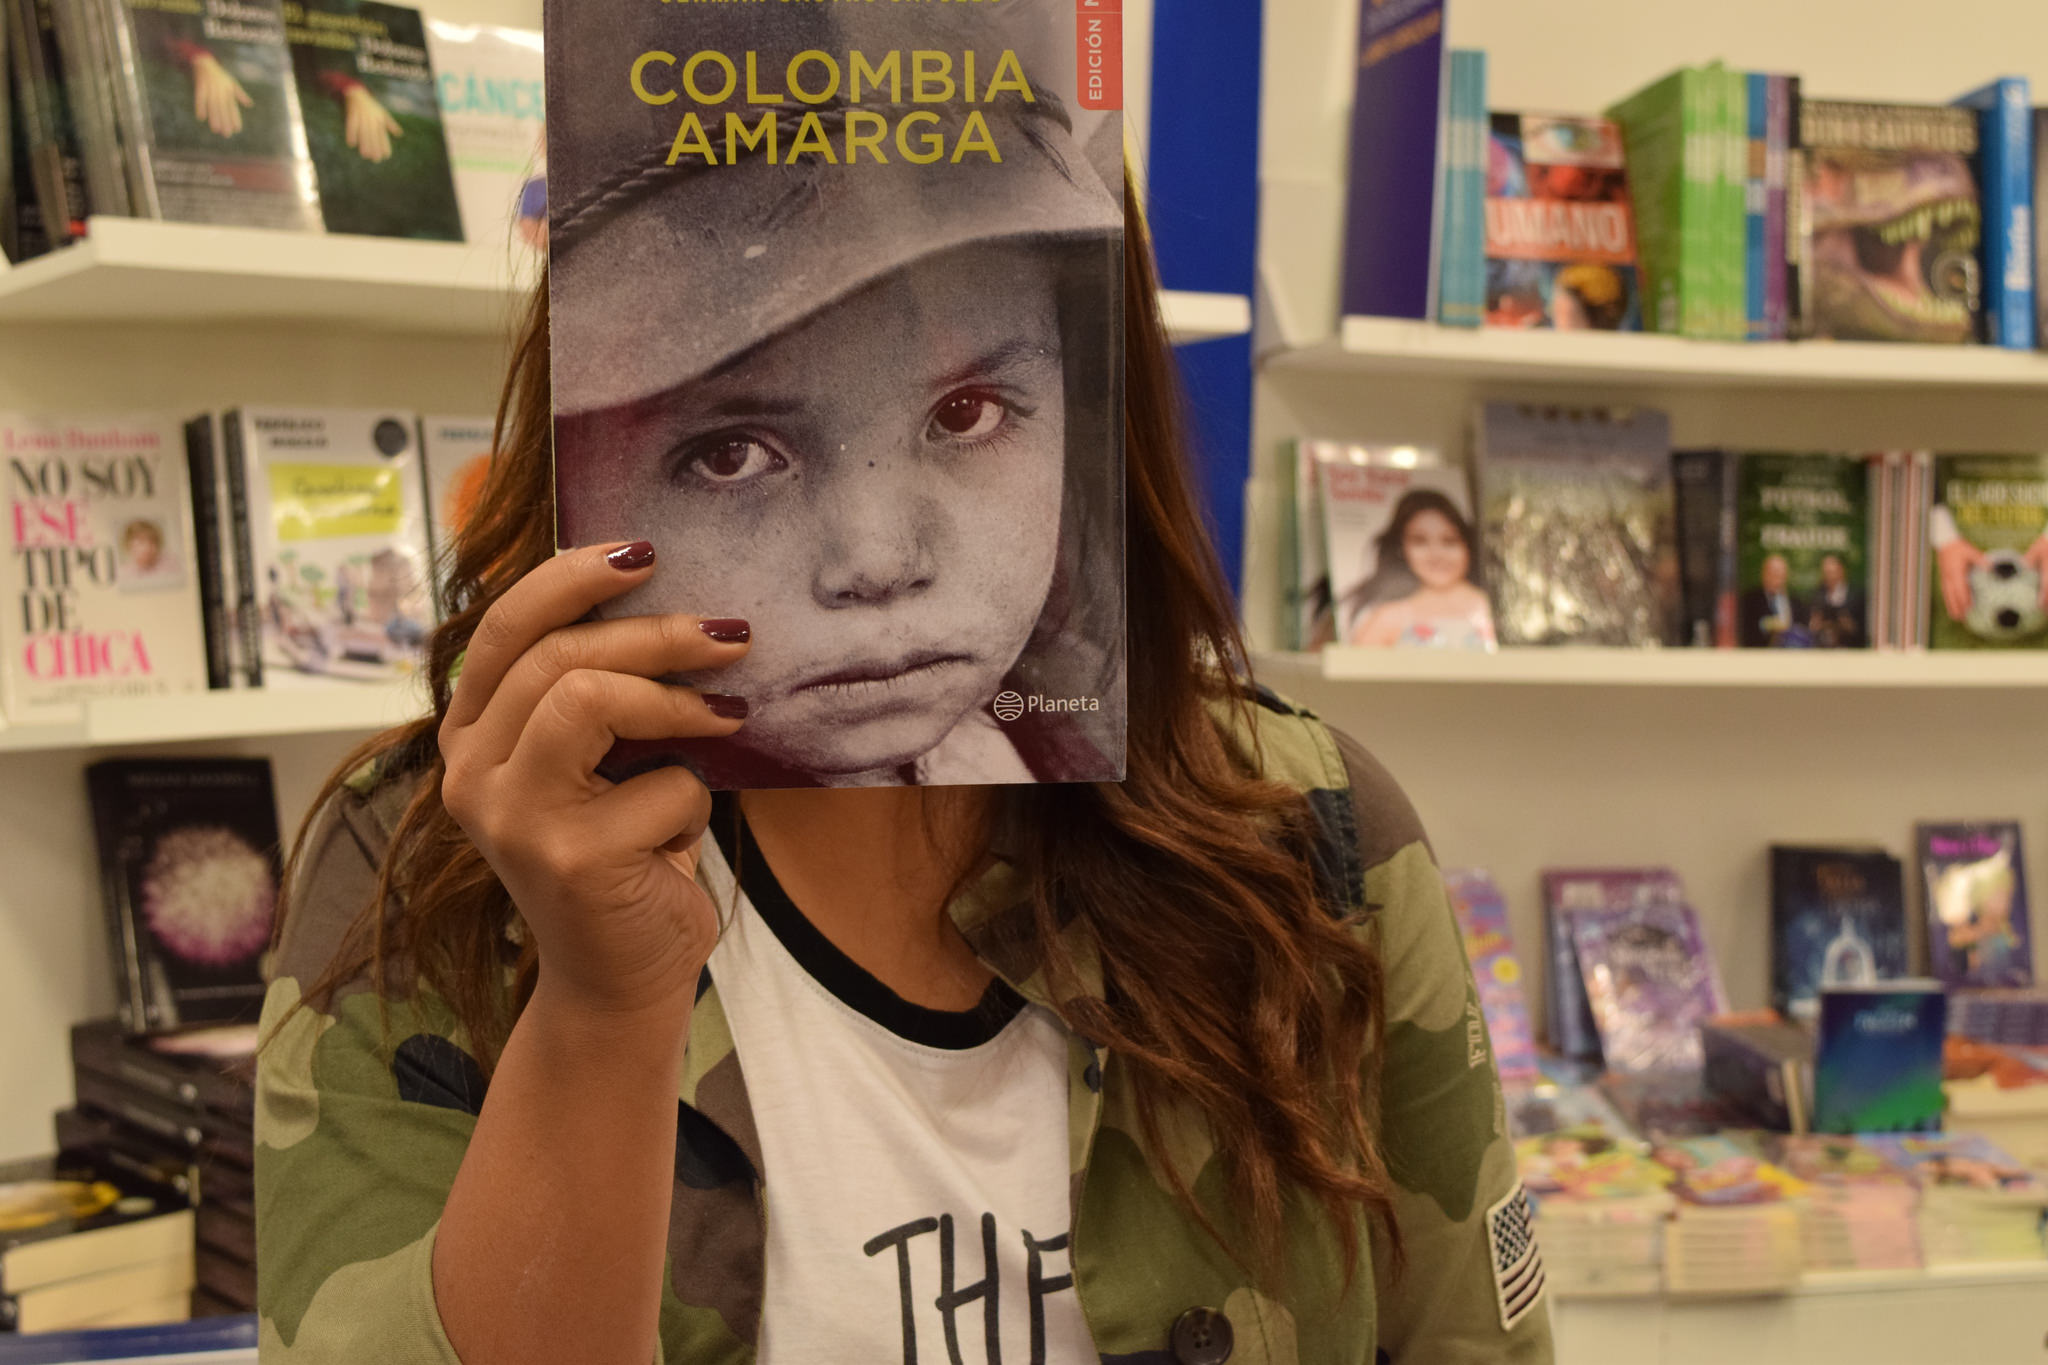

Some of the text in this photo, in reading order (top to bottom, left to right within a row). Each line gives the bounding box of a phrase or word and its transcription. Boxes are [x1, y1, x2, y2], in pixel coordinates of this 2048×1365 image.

[630, 49, 1036, 104] COLOMBIA
[1085, 19, 1102, 100] EDICIÓN
[665, 110, 1003, 166] AMARGA
[10, 453, 160, 498] NO SOY
[12, 500, 94, 548] ESE
[16, 546, 118, 587] TIPO
[21, 591, 81, 634] DE
[24, 630, 152, 680] CHICA
[1028, 694, 1100, 712] Planeta
